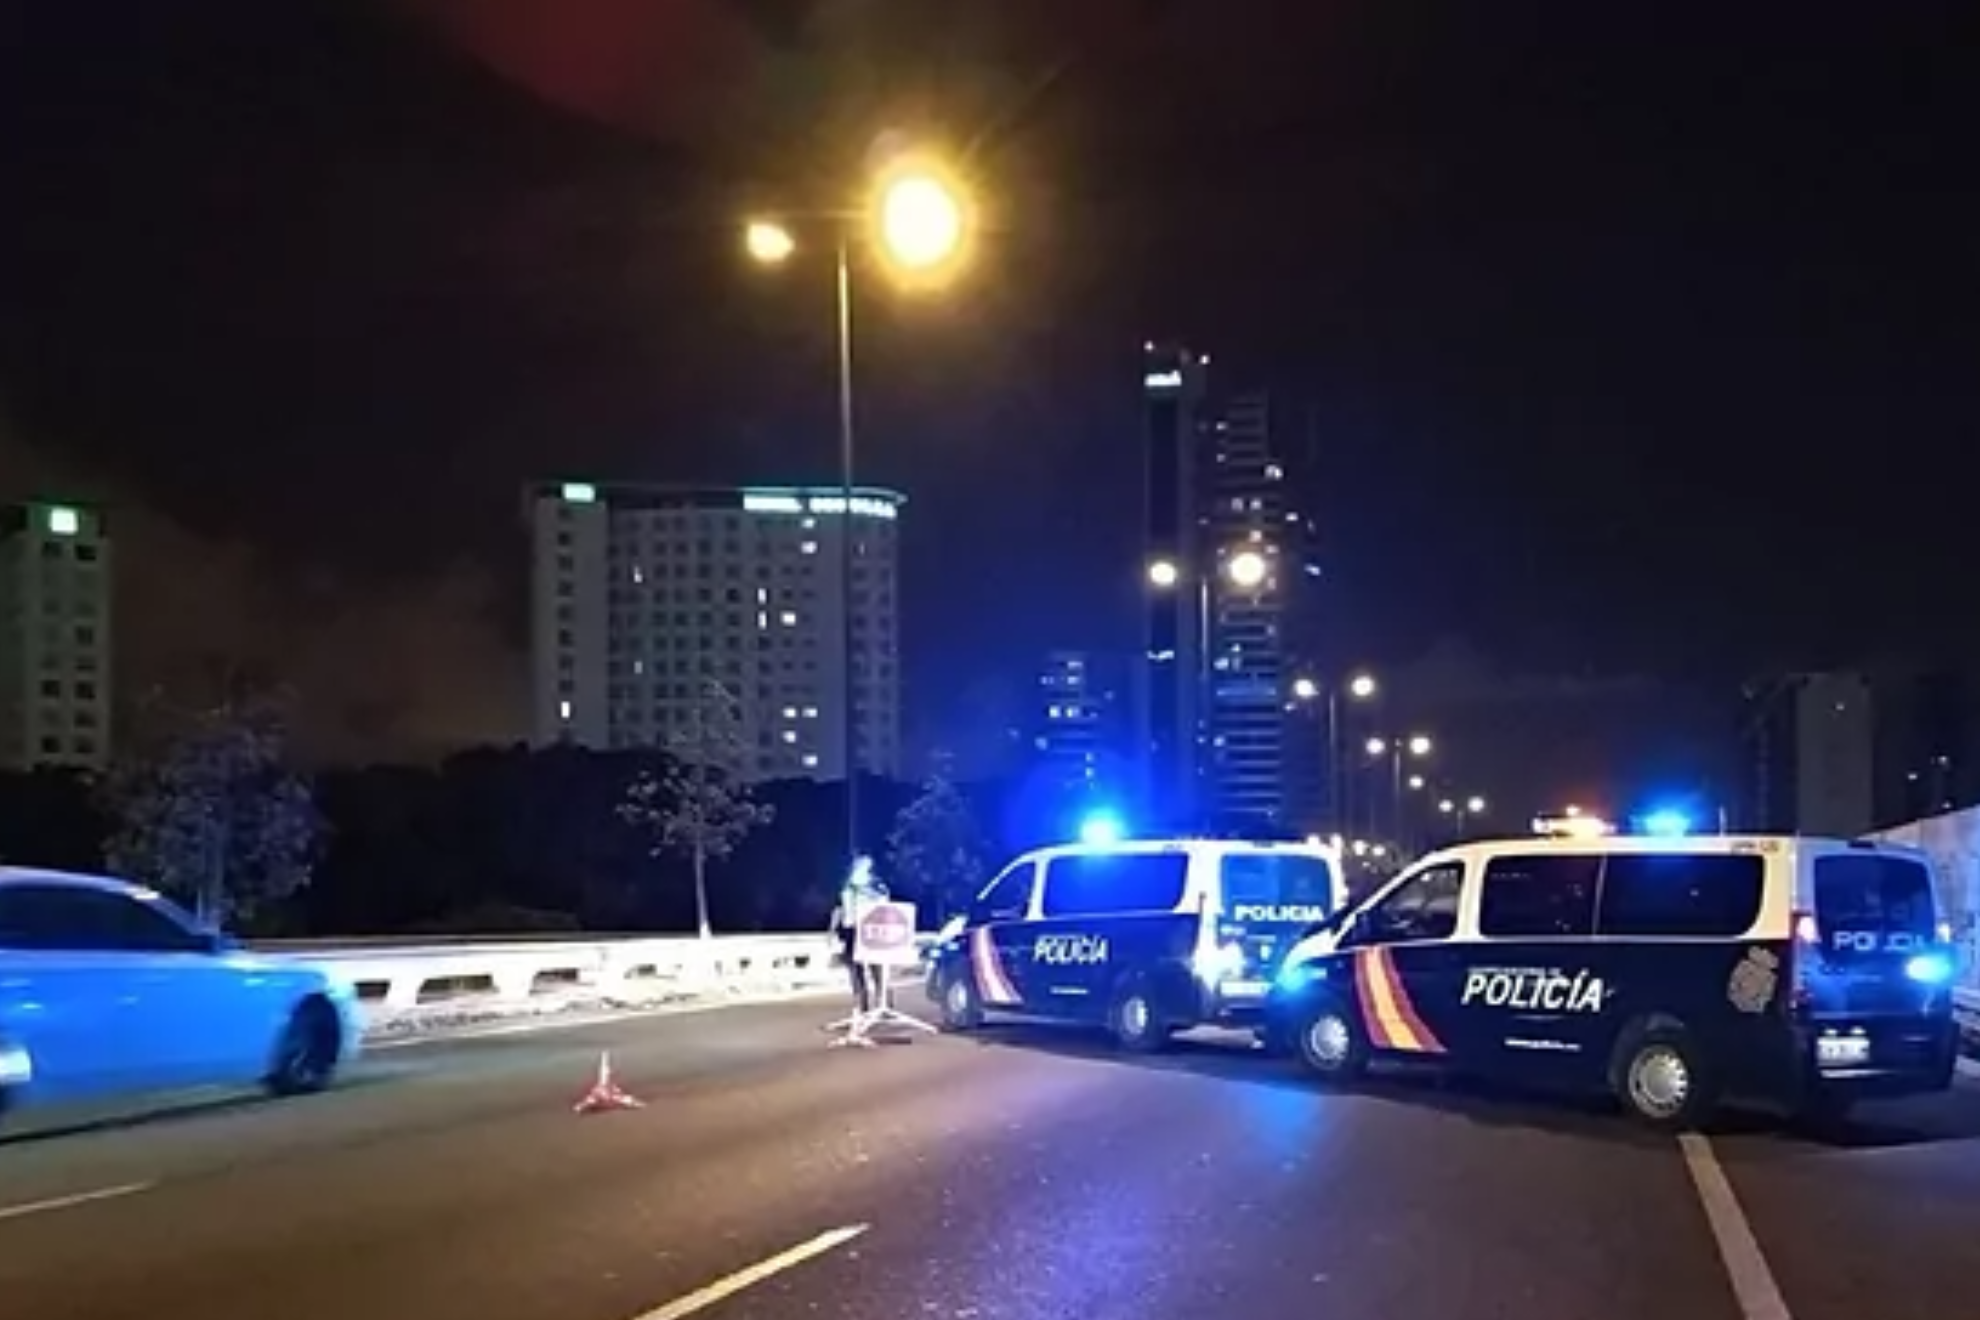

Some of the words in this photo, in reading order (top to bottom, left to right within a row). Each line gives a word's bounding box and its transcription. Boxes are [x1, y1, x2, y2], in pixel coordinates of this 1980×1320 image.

[1234, 905, 1324, 921] POLICIA
[1832, 931, 1927, 951] POICIA
[1460, 968, 1603, 1013] POLICÍA
